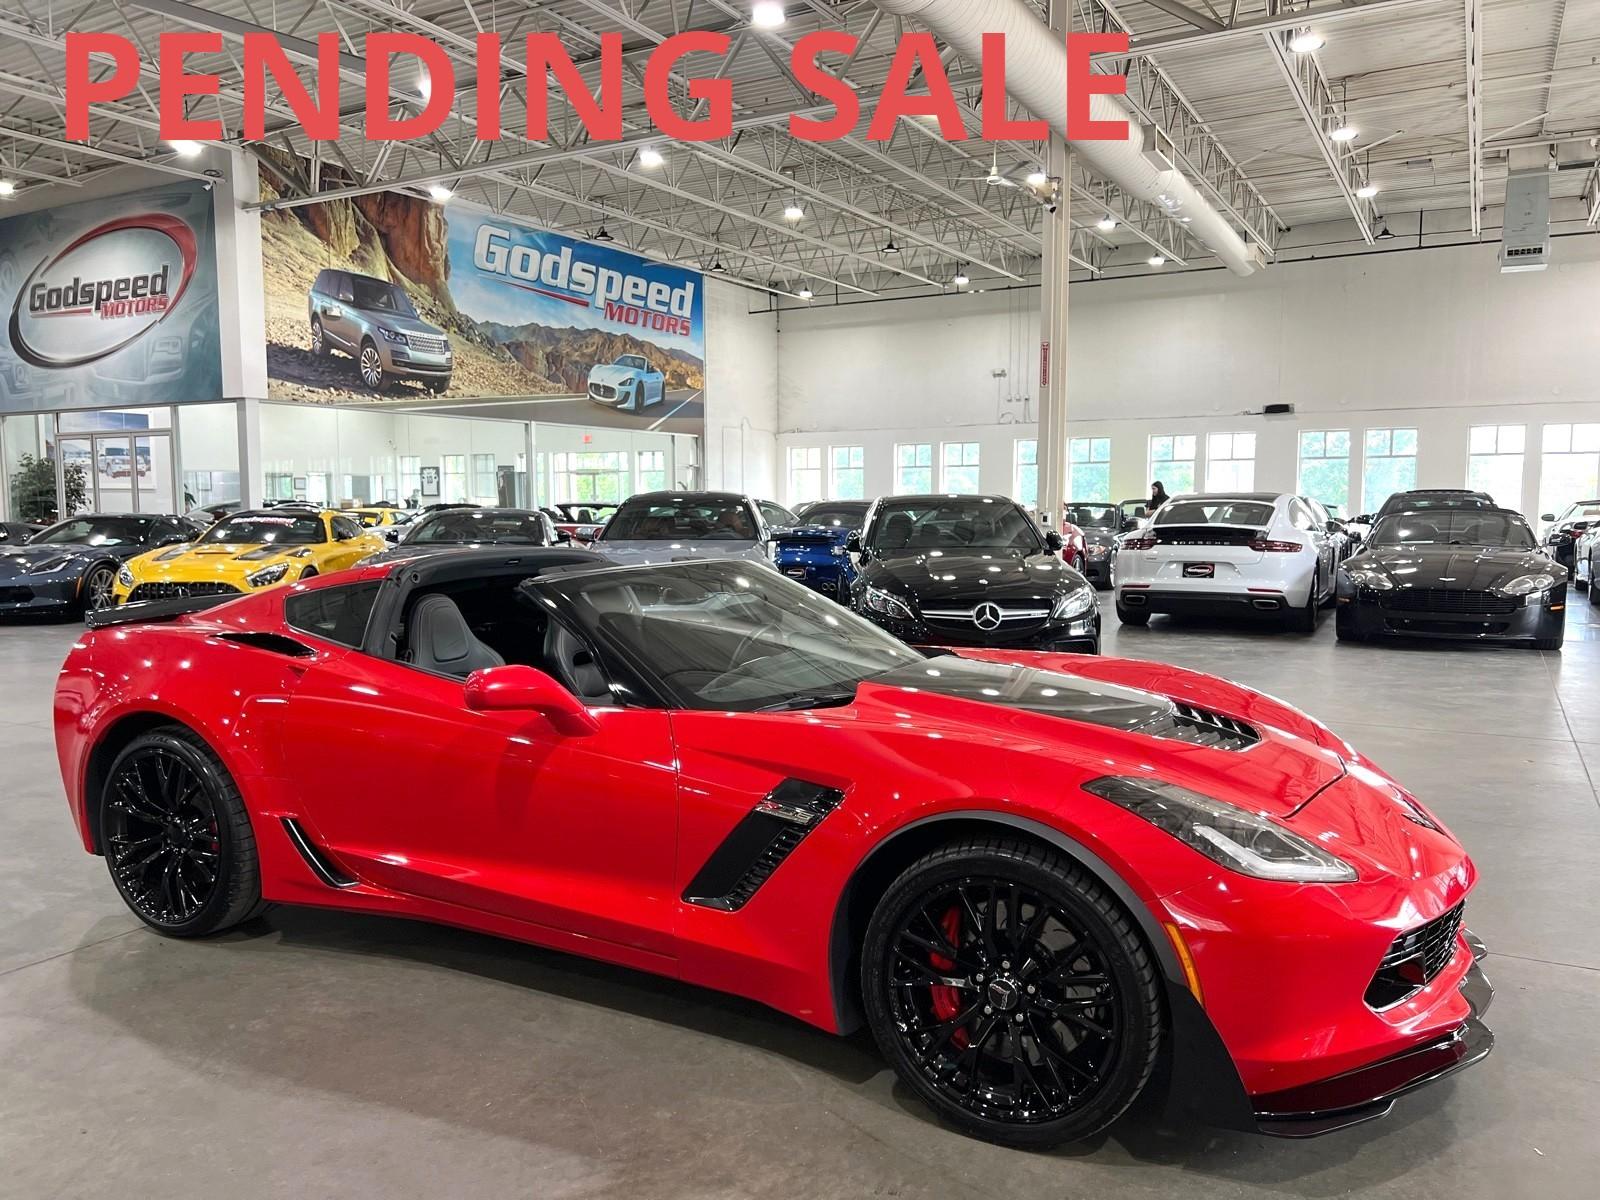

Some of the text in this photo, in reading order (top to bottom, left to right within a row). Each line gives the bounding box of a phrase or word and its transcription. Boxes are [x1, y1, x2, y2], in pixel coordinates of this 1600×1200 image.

[29, 264, 170, 312] Godspeed
[474, 223, 695, 319] Godspeed
[101, 296, 169, 320] MOTORS
[603, 301, 692, 337] MOTORS
